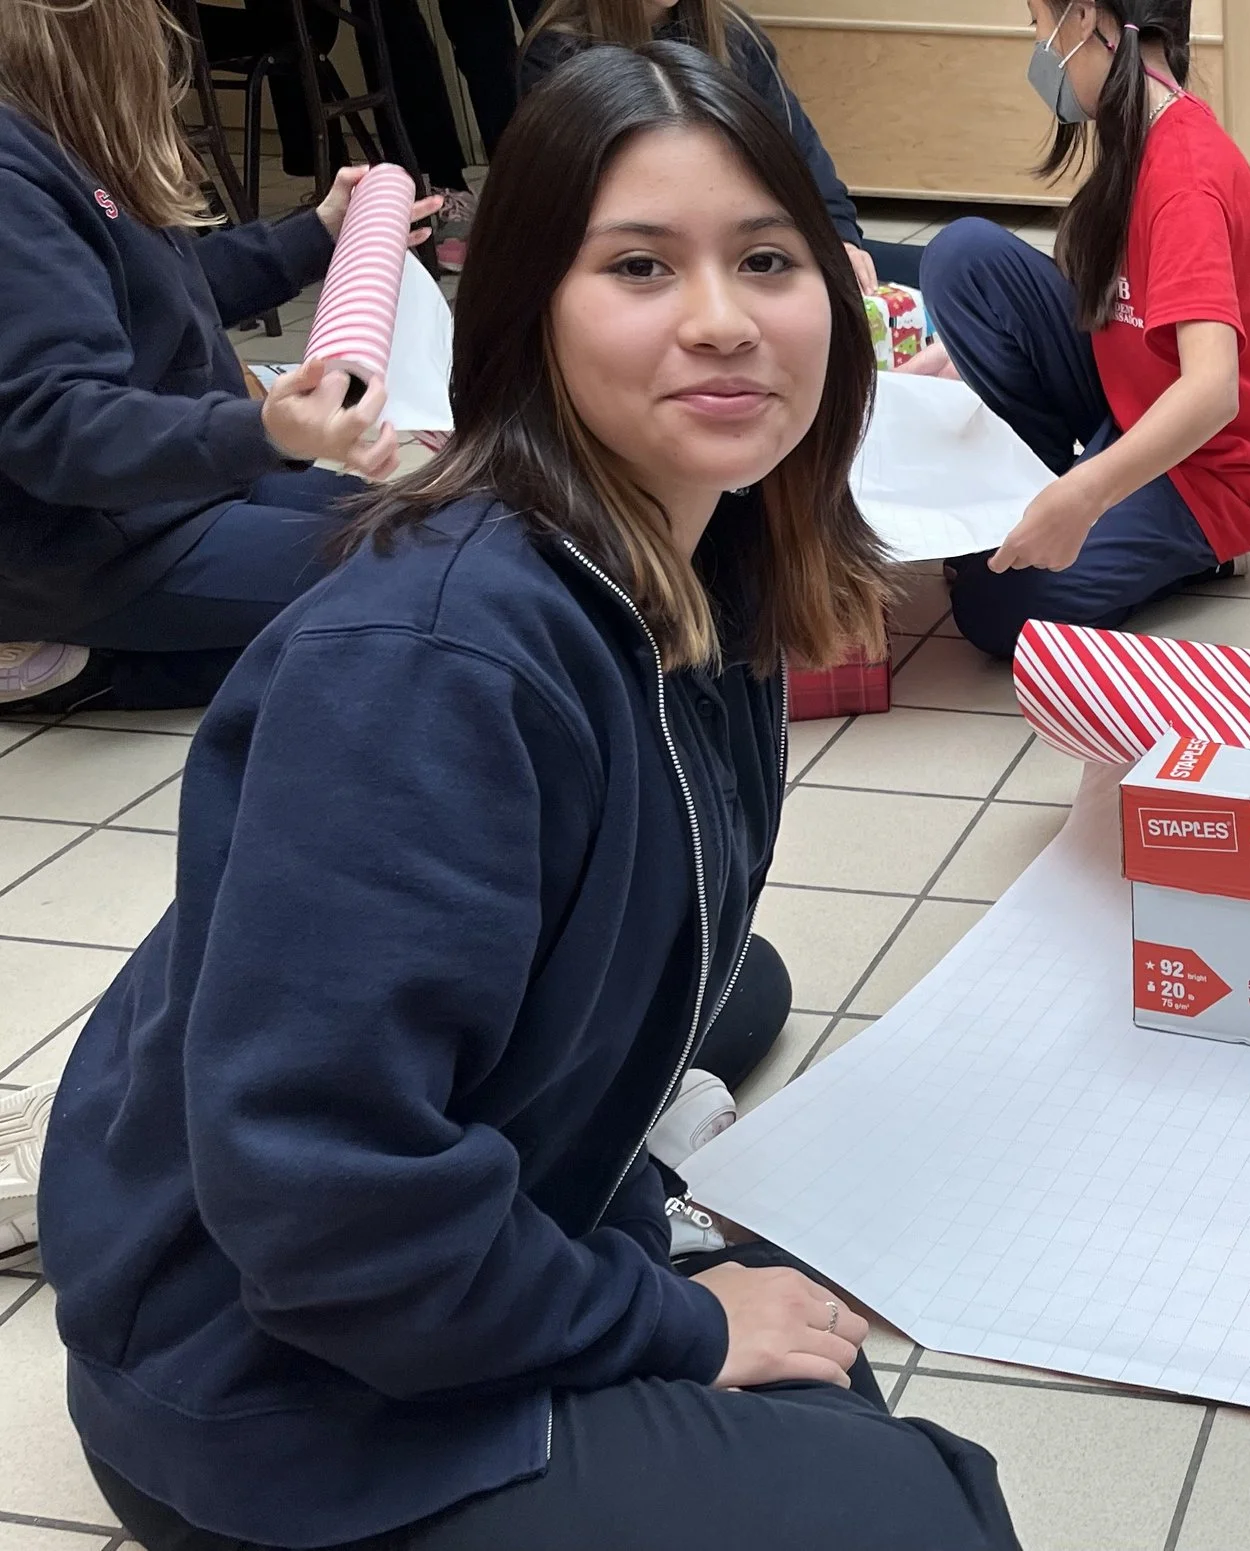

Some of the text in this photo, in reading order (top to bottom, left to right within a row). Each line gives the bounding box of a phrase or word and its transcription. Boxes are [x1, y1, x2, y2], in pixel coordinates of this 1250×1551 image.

[94, 189, 118, 219] S
[1169, 738, 1211, 778] STAPLES
[1160, 959, 1207, 983] 92 bright
[1161, 980, 1185, 999] 20
[1161, 997, 1173, 1008] 75
